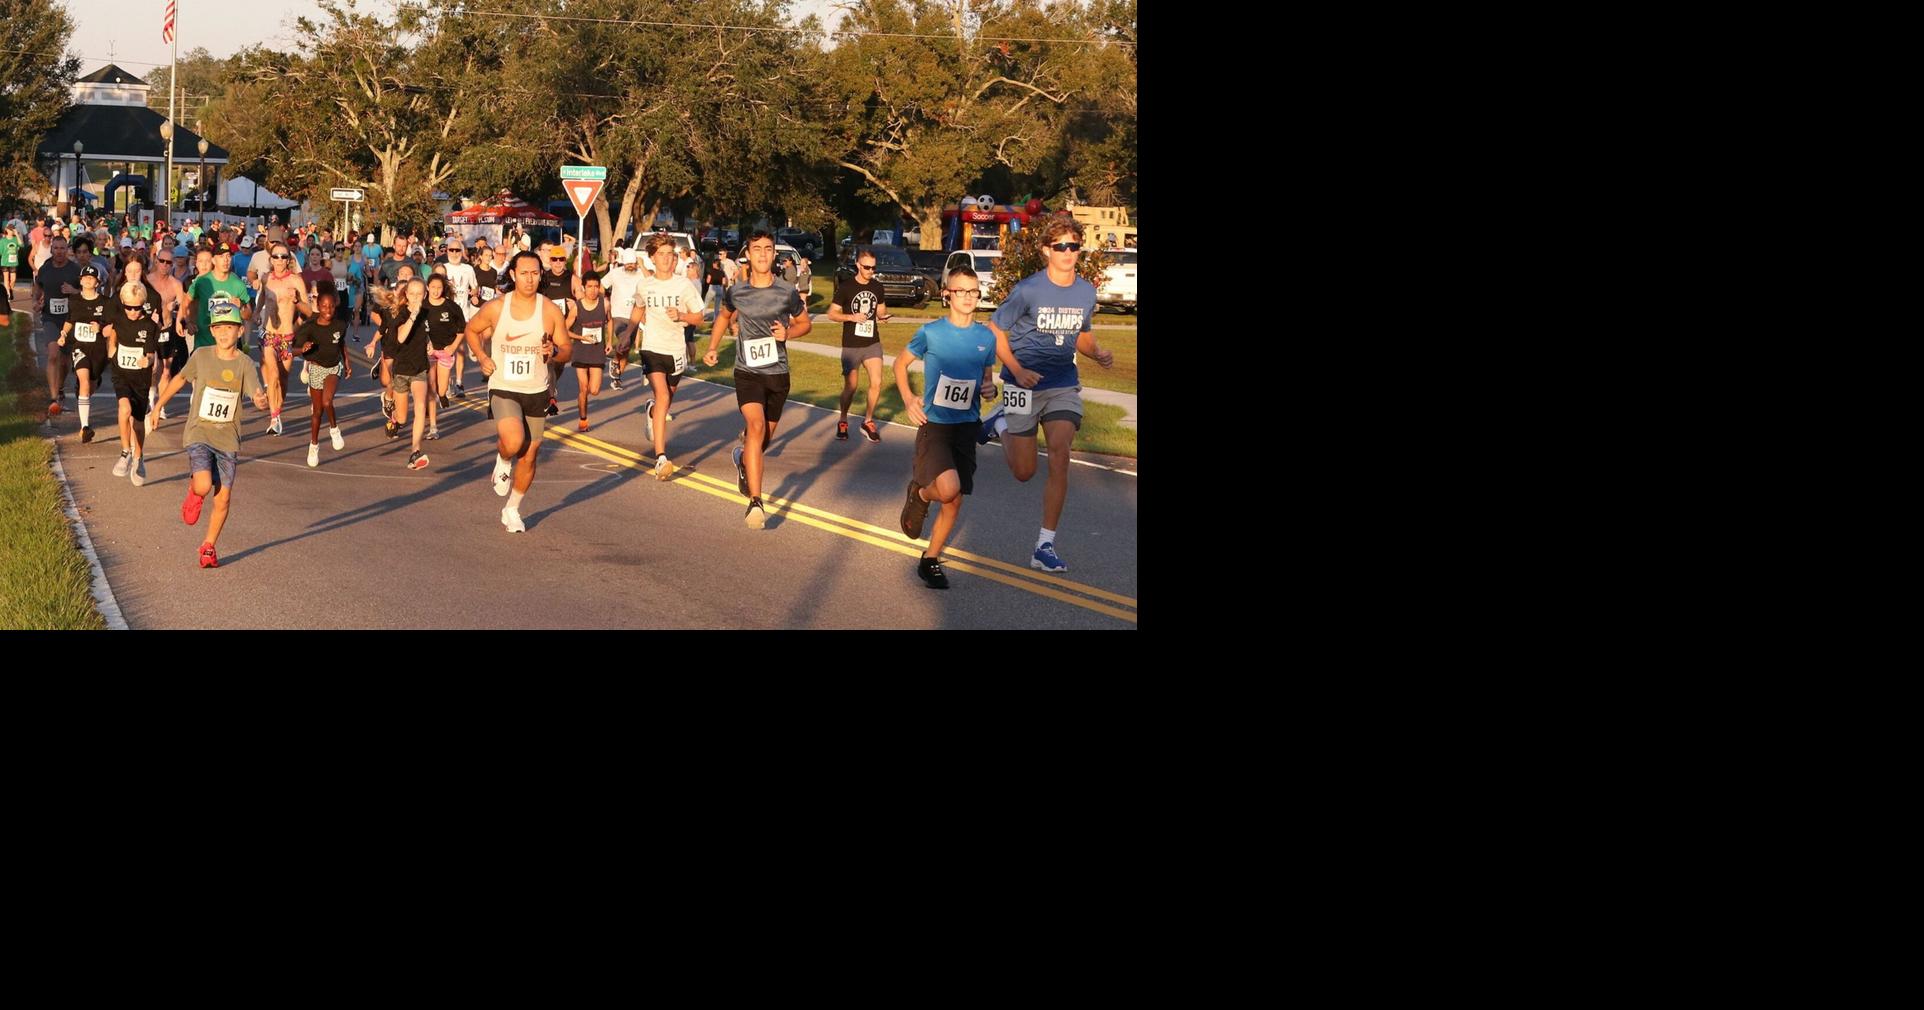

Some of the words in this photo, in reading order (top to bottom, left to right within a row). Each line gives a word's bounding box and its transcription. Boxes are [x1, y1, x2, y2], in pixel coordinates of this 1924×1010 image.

[972, 212, 995, 220] Soccer
[647, 295, 680, 308] ELITE
[54, 305, 65, 313] 197
[1058, 307, 1084, 315] DISTRICT
[1037, 313, 1084, 330] CHAMPS
[500, 344, 522, 355] STOP
[750, 343, 771, 360] 647
[121, 355, 137, 367] 172
[510, 360, 530, 375] 161
[944, 384, 970, 403] 164
[1003, 390, 1026, 408] 656
[207, 402, 229, 419] 184
